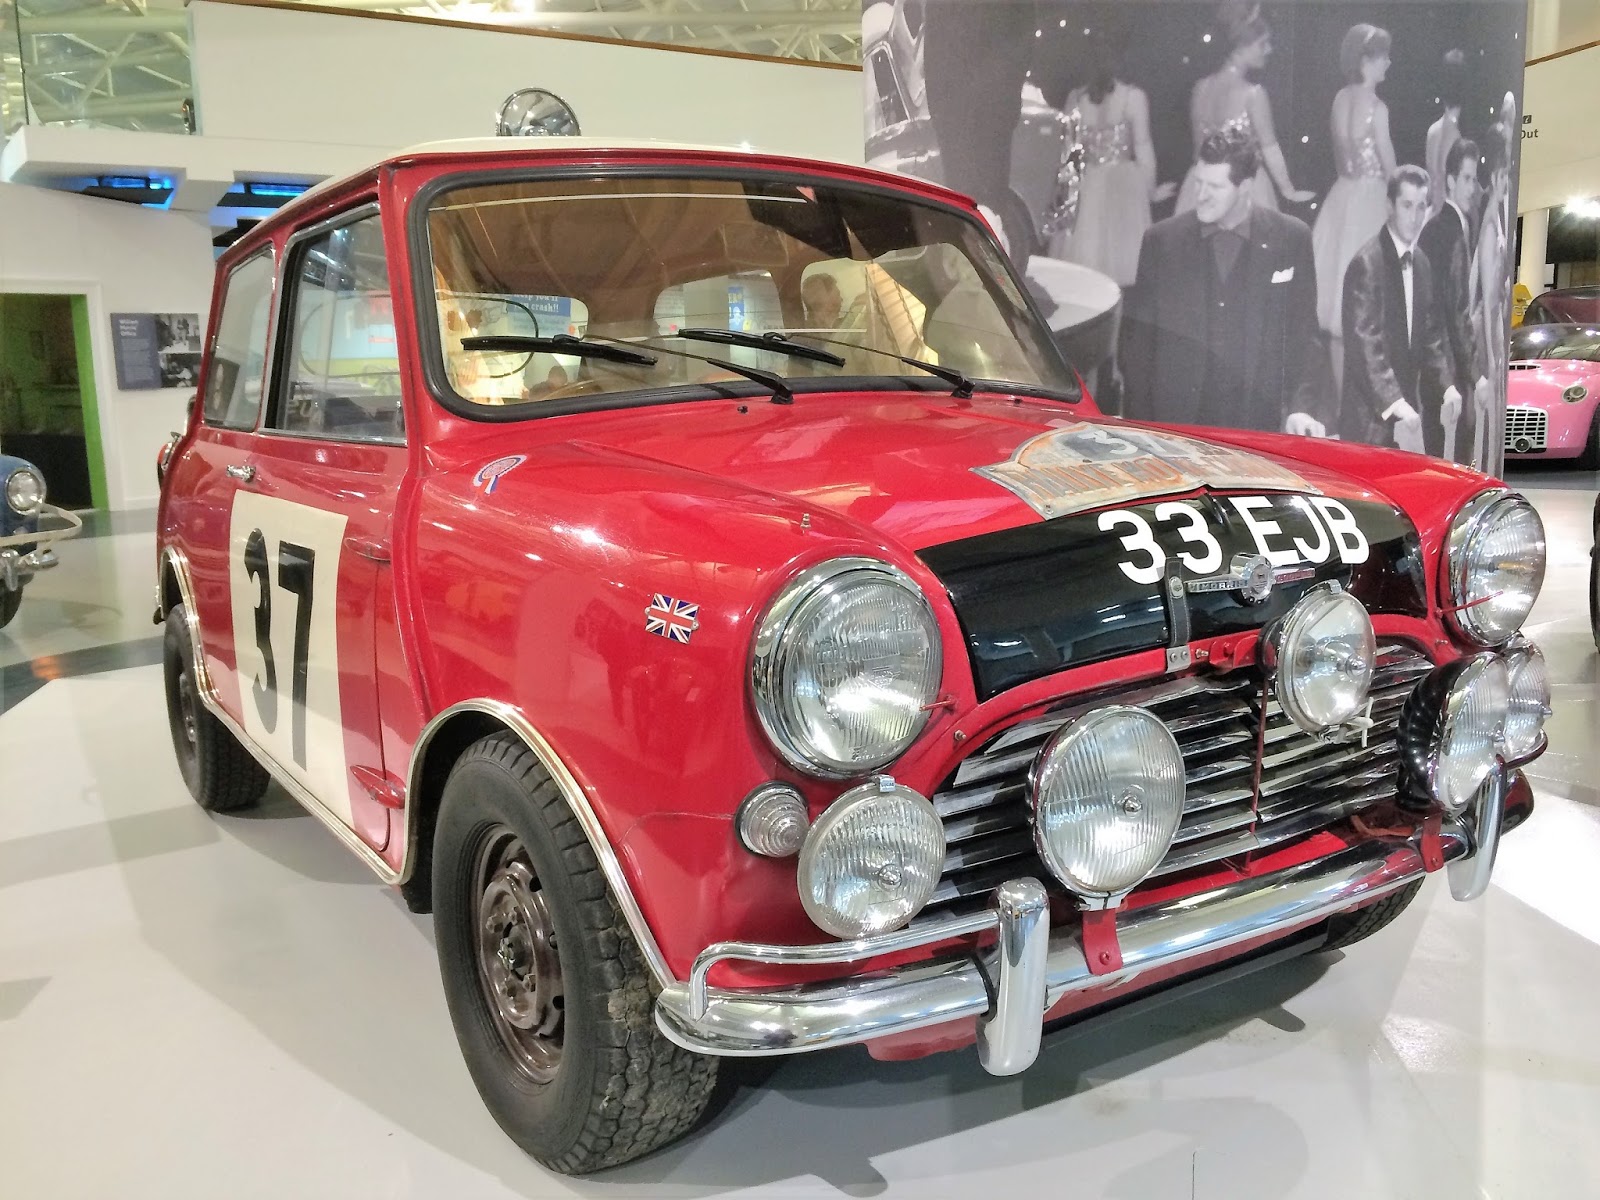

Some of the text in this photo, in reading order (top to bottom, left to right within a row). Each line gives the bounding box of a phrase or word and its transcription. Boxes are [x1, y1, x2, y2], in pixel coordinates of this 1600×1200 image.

[1097, 496, 1369, 585] 33 EJB
[244, 528, 315, 771] 37
